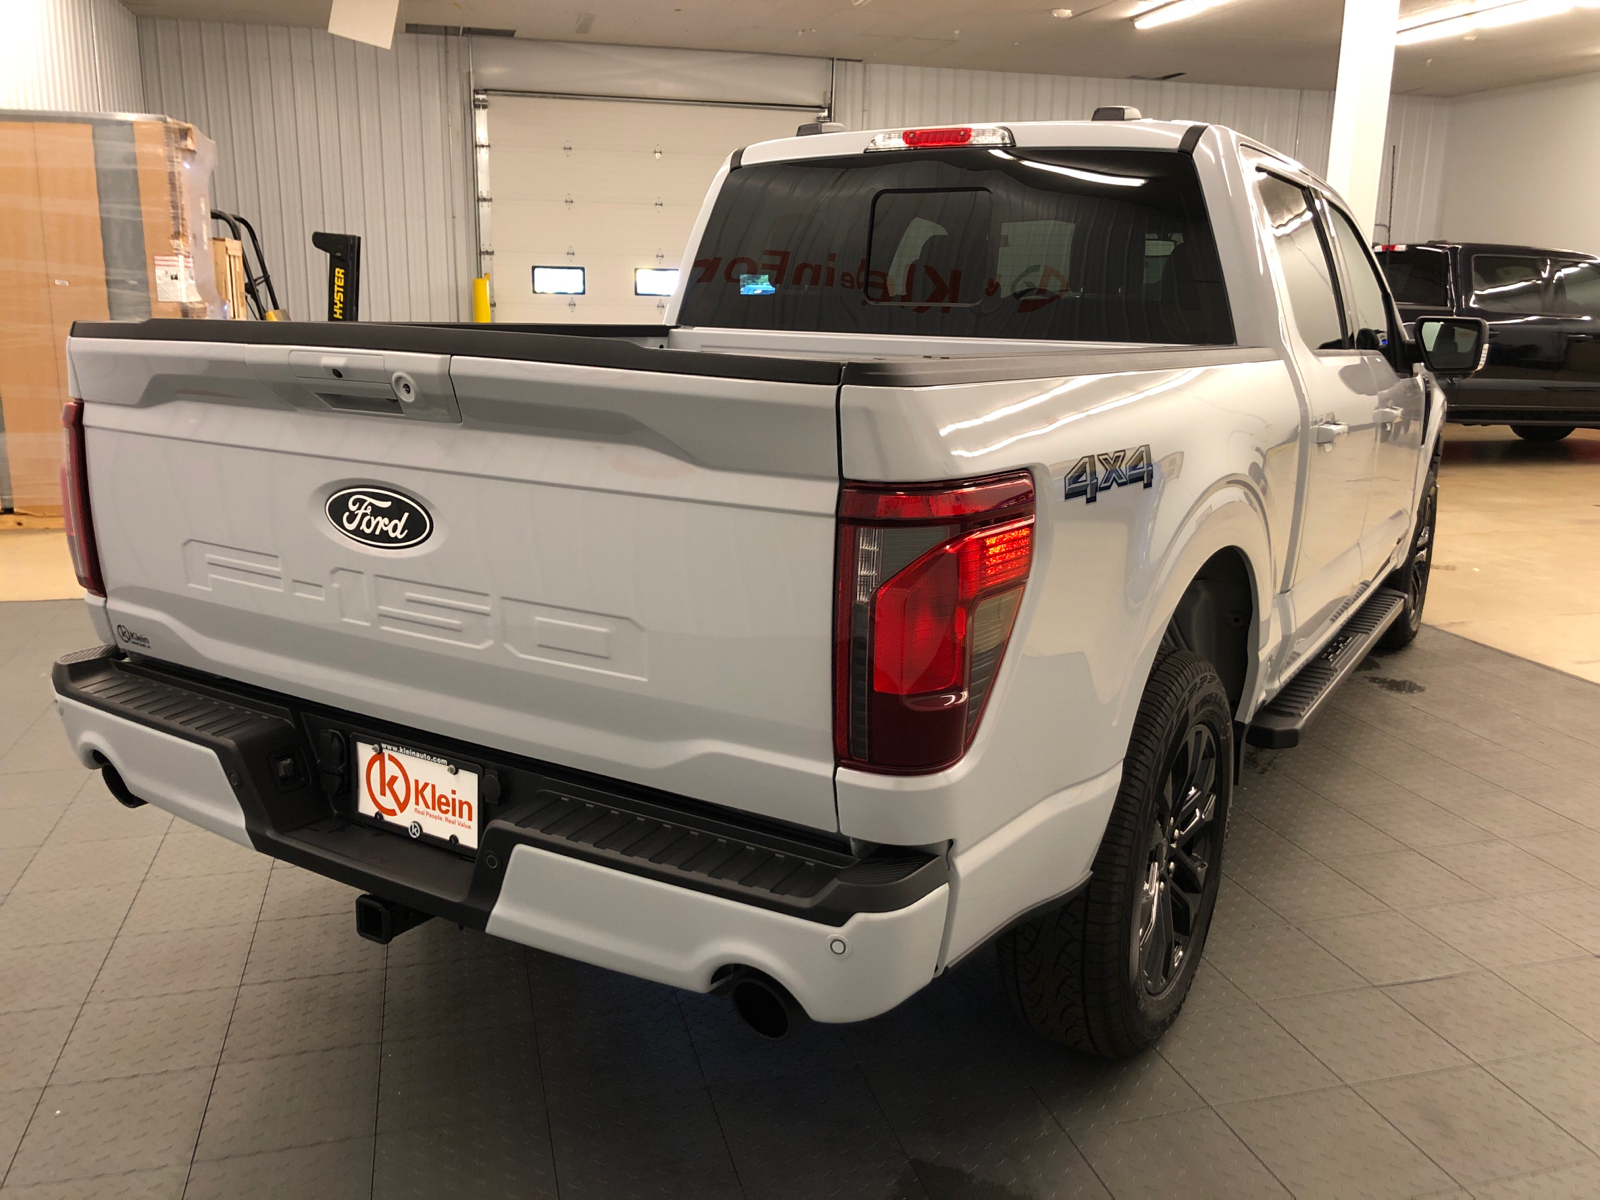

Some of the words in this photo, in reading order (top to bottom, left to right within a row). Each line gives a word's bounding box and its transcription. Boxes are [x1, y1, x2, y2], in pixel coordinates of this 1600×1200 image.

[333, 267, 345, 319] HYSTER
[342, 494, 410, 539] Ford
[182, 539, 649, 683] F-150
[381, 743, 448, 766] www.kleinauto.com
[414, 778, 473, 822] Klein
[414, 808, 425, 816] Real
[445, 817, 456, 825] Real
